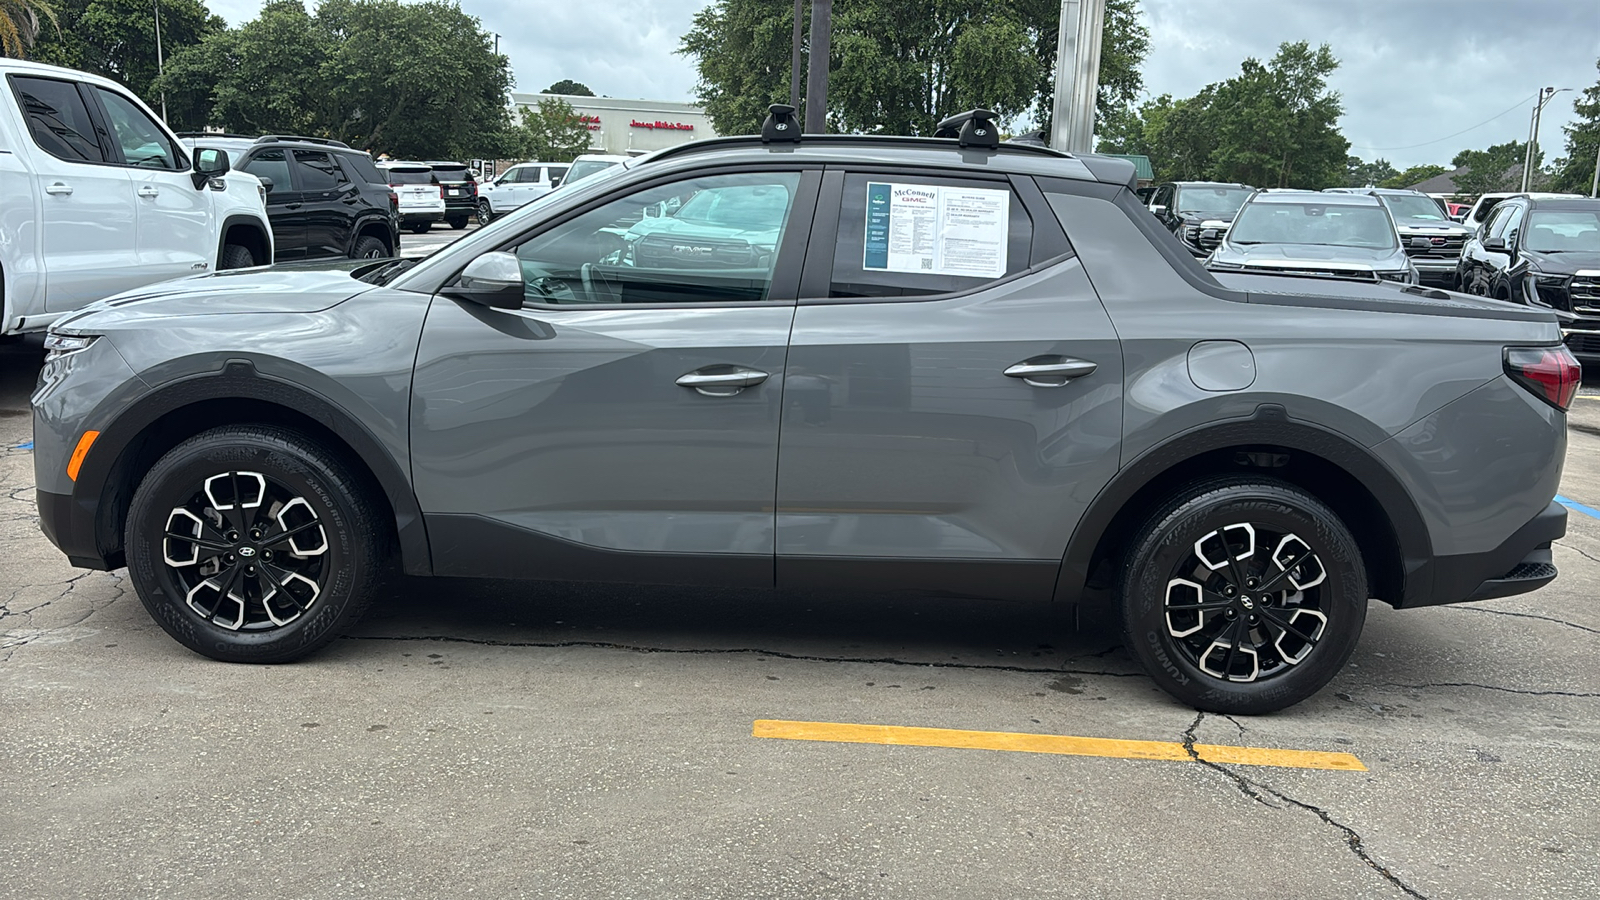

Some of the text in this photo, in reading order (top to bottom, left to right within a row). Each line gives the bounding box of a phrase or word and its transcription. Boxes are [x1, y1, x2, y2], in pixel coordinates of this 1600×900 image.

[894, 189, 935, 199] McConnell
[305, 478, 333, 508] 245/60
[1147, 630, 1191, 688] KUMHO
